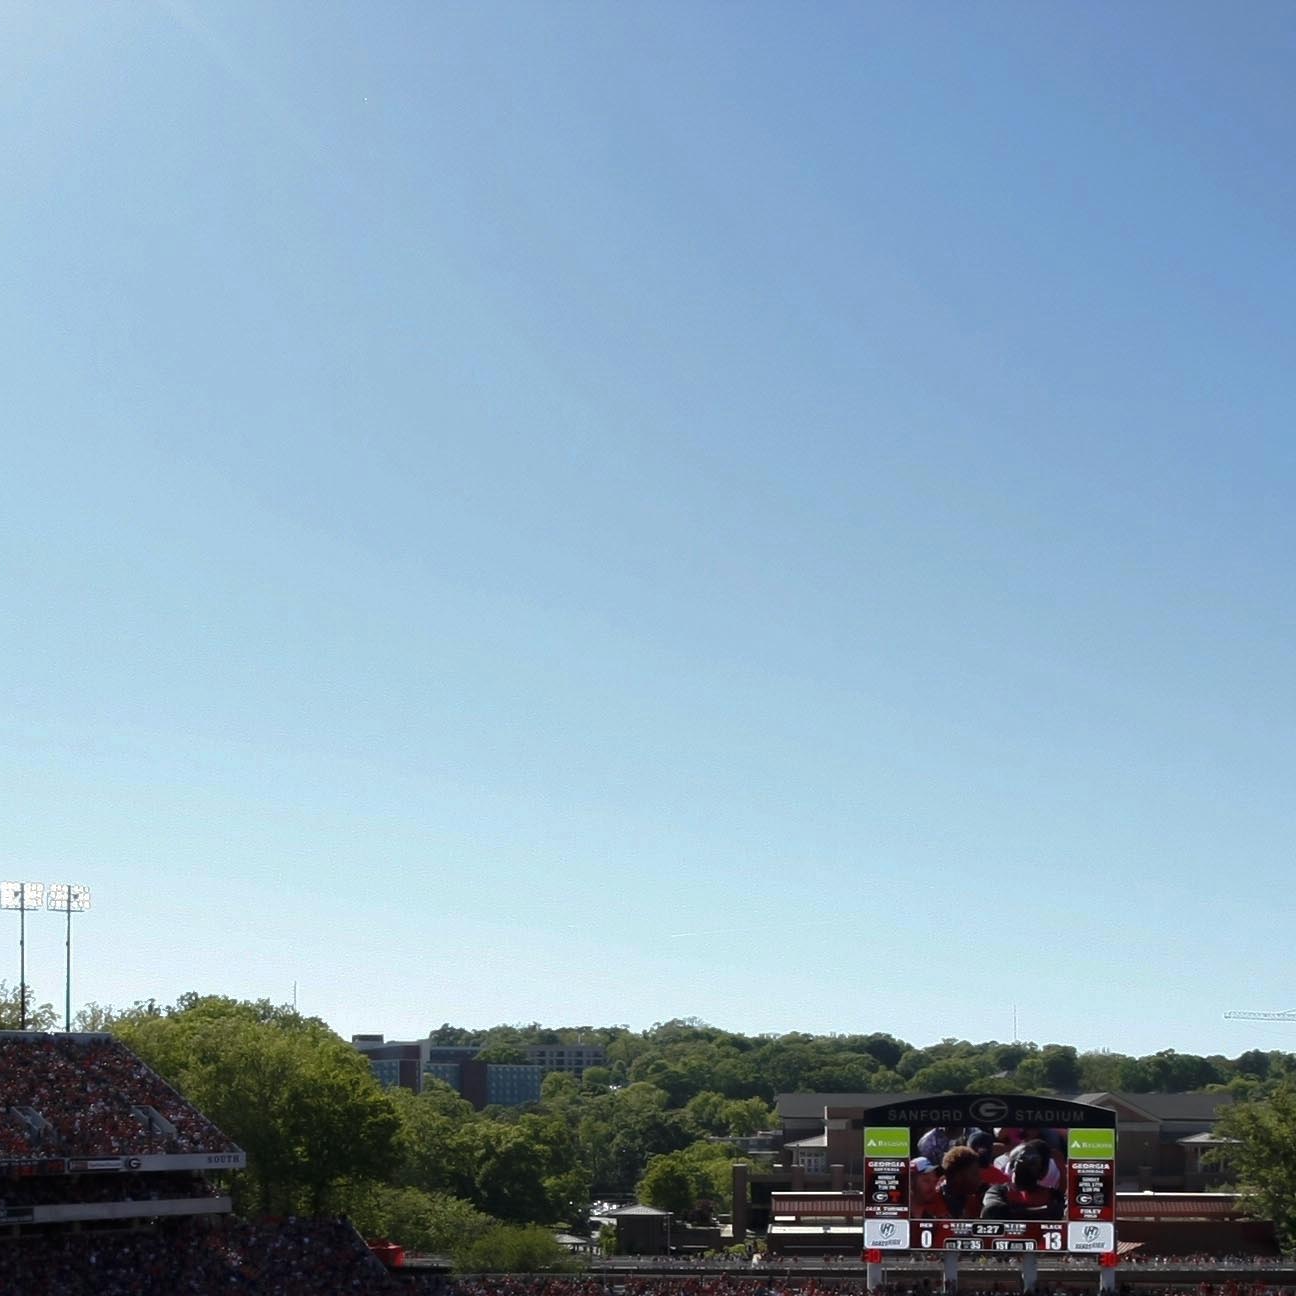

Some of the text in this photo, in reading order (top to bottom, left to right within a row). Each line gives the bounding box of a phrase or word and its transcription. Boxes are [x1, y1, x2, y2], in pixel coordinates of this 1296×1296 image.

[887, 1109, 963, 1121] SANFORD
[1015, 1110, 1085, 1121] STADIUM
[208, 1155, 240, 1164] SOUTH
[977, 1225, 1000, 1234] 2:27
[921, 1230, 933, 1248] 0
[1043, 1232, 1062, 1250] 13
